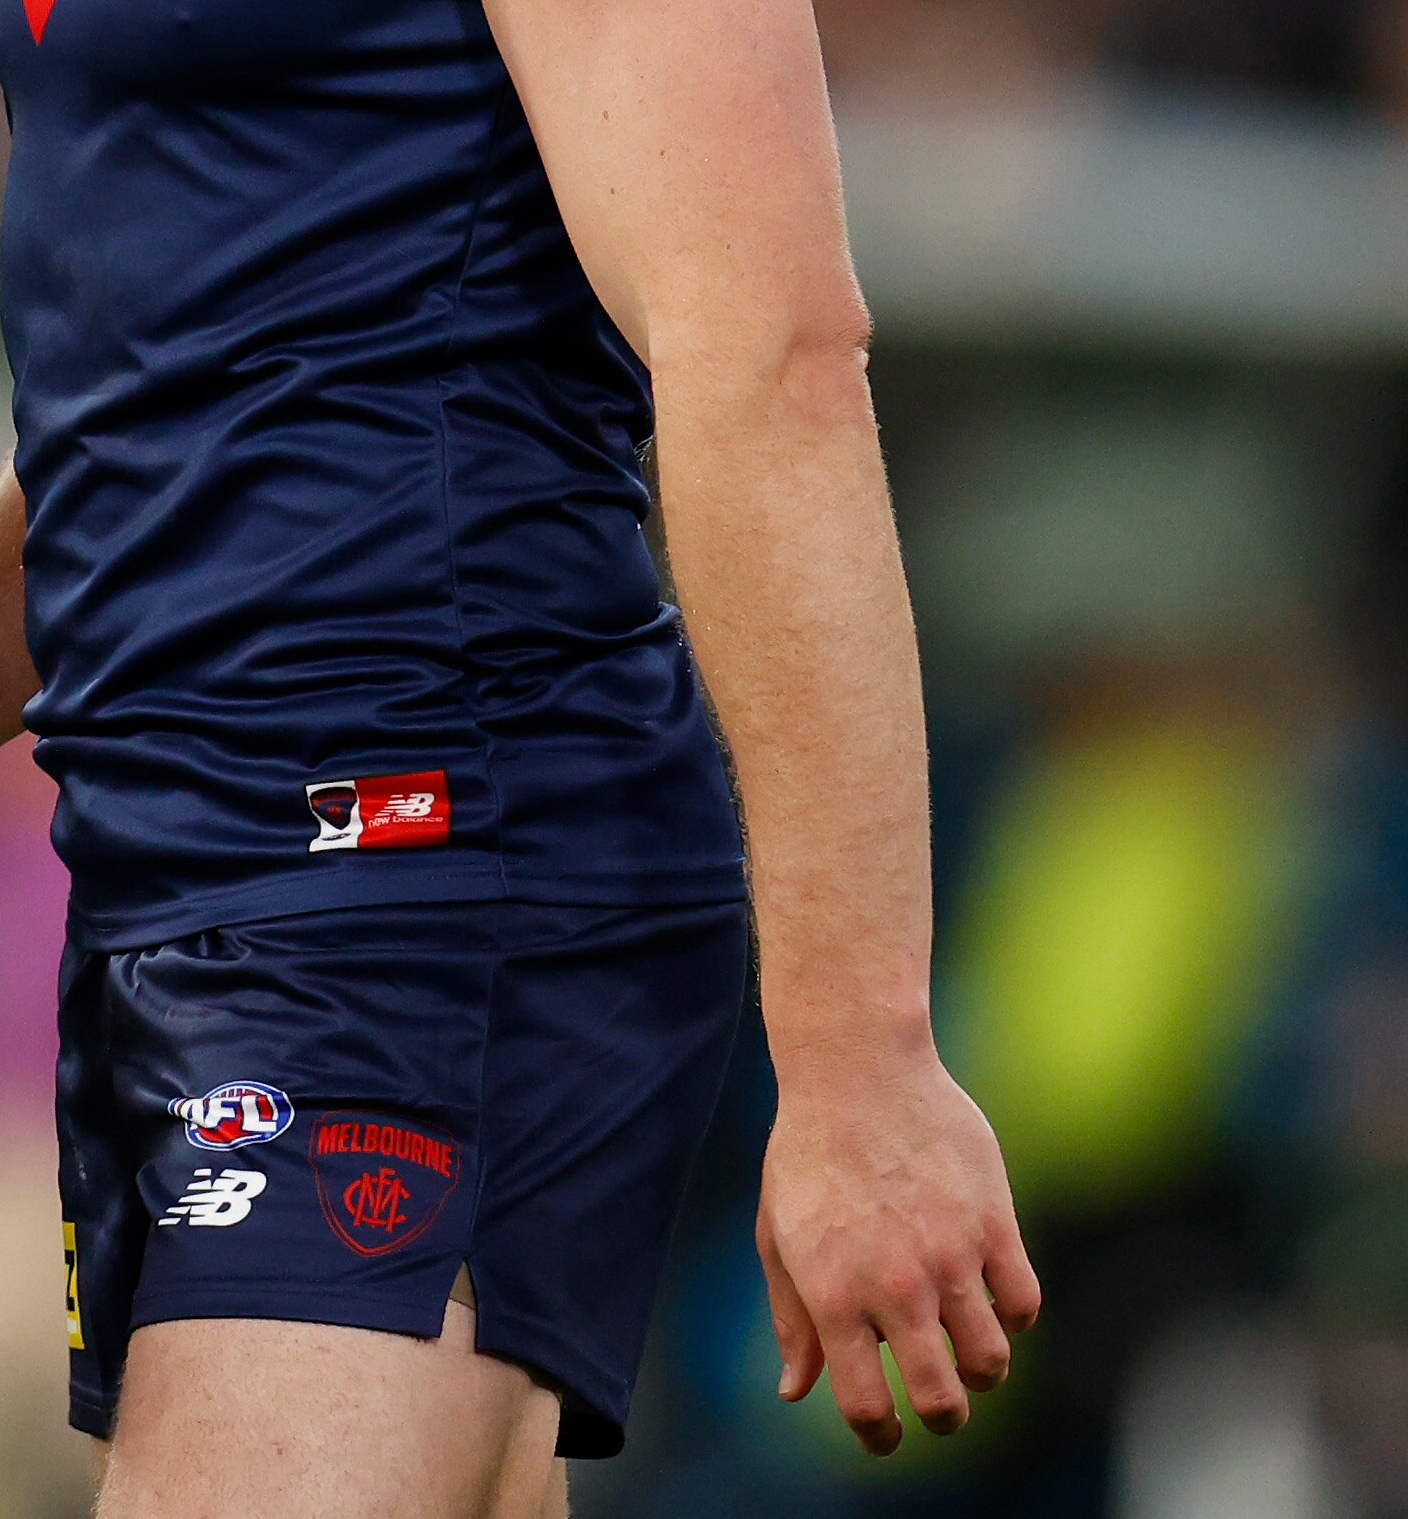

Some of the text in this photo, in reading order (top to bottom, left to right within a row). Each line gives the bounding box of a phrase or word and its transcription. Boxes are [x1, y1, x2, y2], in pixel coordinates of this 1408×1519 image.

[368, 816, 391, 829] new
[180, 1094, 277, 1133] AFL
[316, 1122, 454, 1179] MELBOURNE
